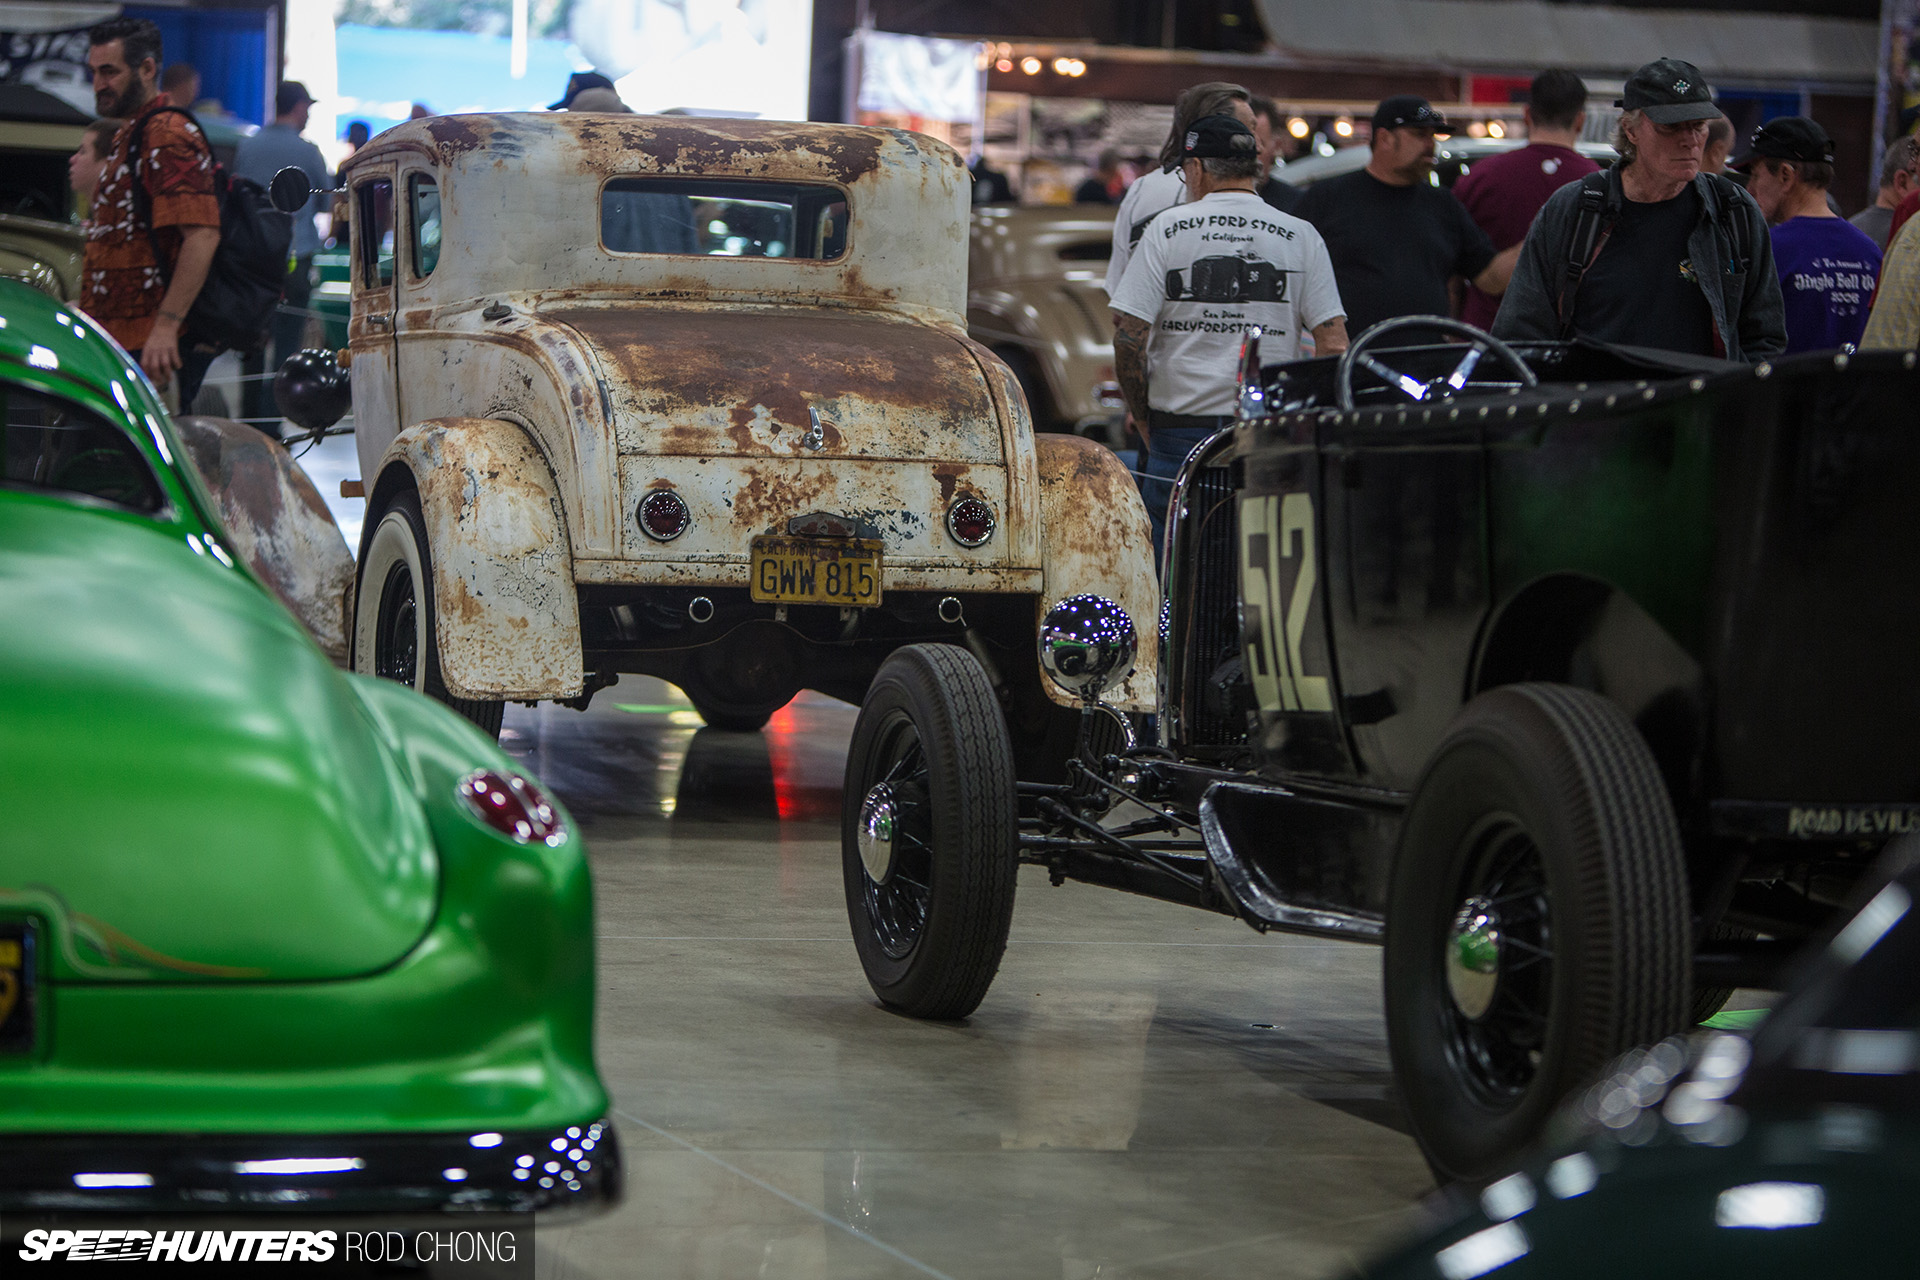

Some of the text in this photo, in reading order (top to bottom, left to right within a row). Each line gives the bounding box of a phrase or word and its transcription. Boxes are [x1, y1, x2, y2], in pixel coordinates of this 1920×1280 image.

[1164, 216, 1295, 241] EARLY FORD STORE
[1202, 233, 1254, 243] of California
[1249, 271, 1260, 282] 36
[1203, 309, 1245, 319] San Dimas
[760, 559, 873, 598] GWW 815
[1241, 493, 1333, 711] 512
[1788, 807, 1842, 839] ROAD
